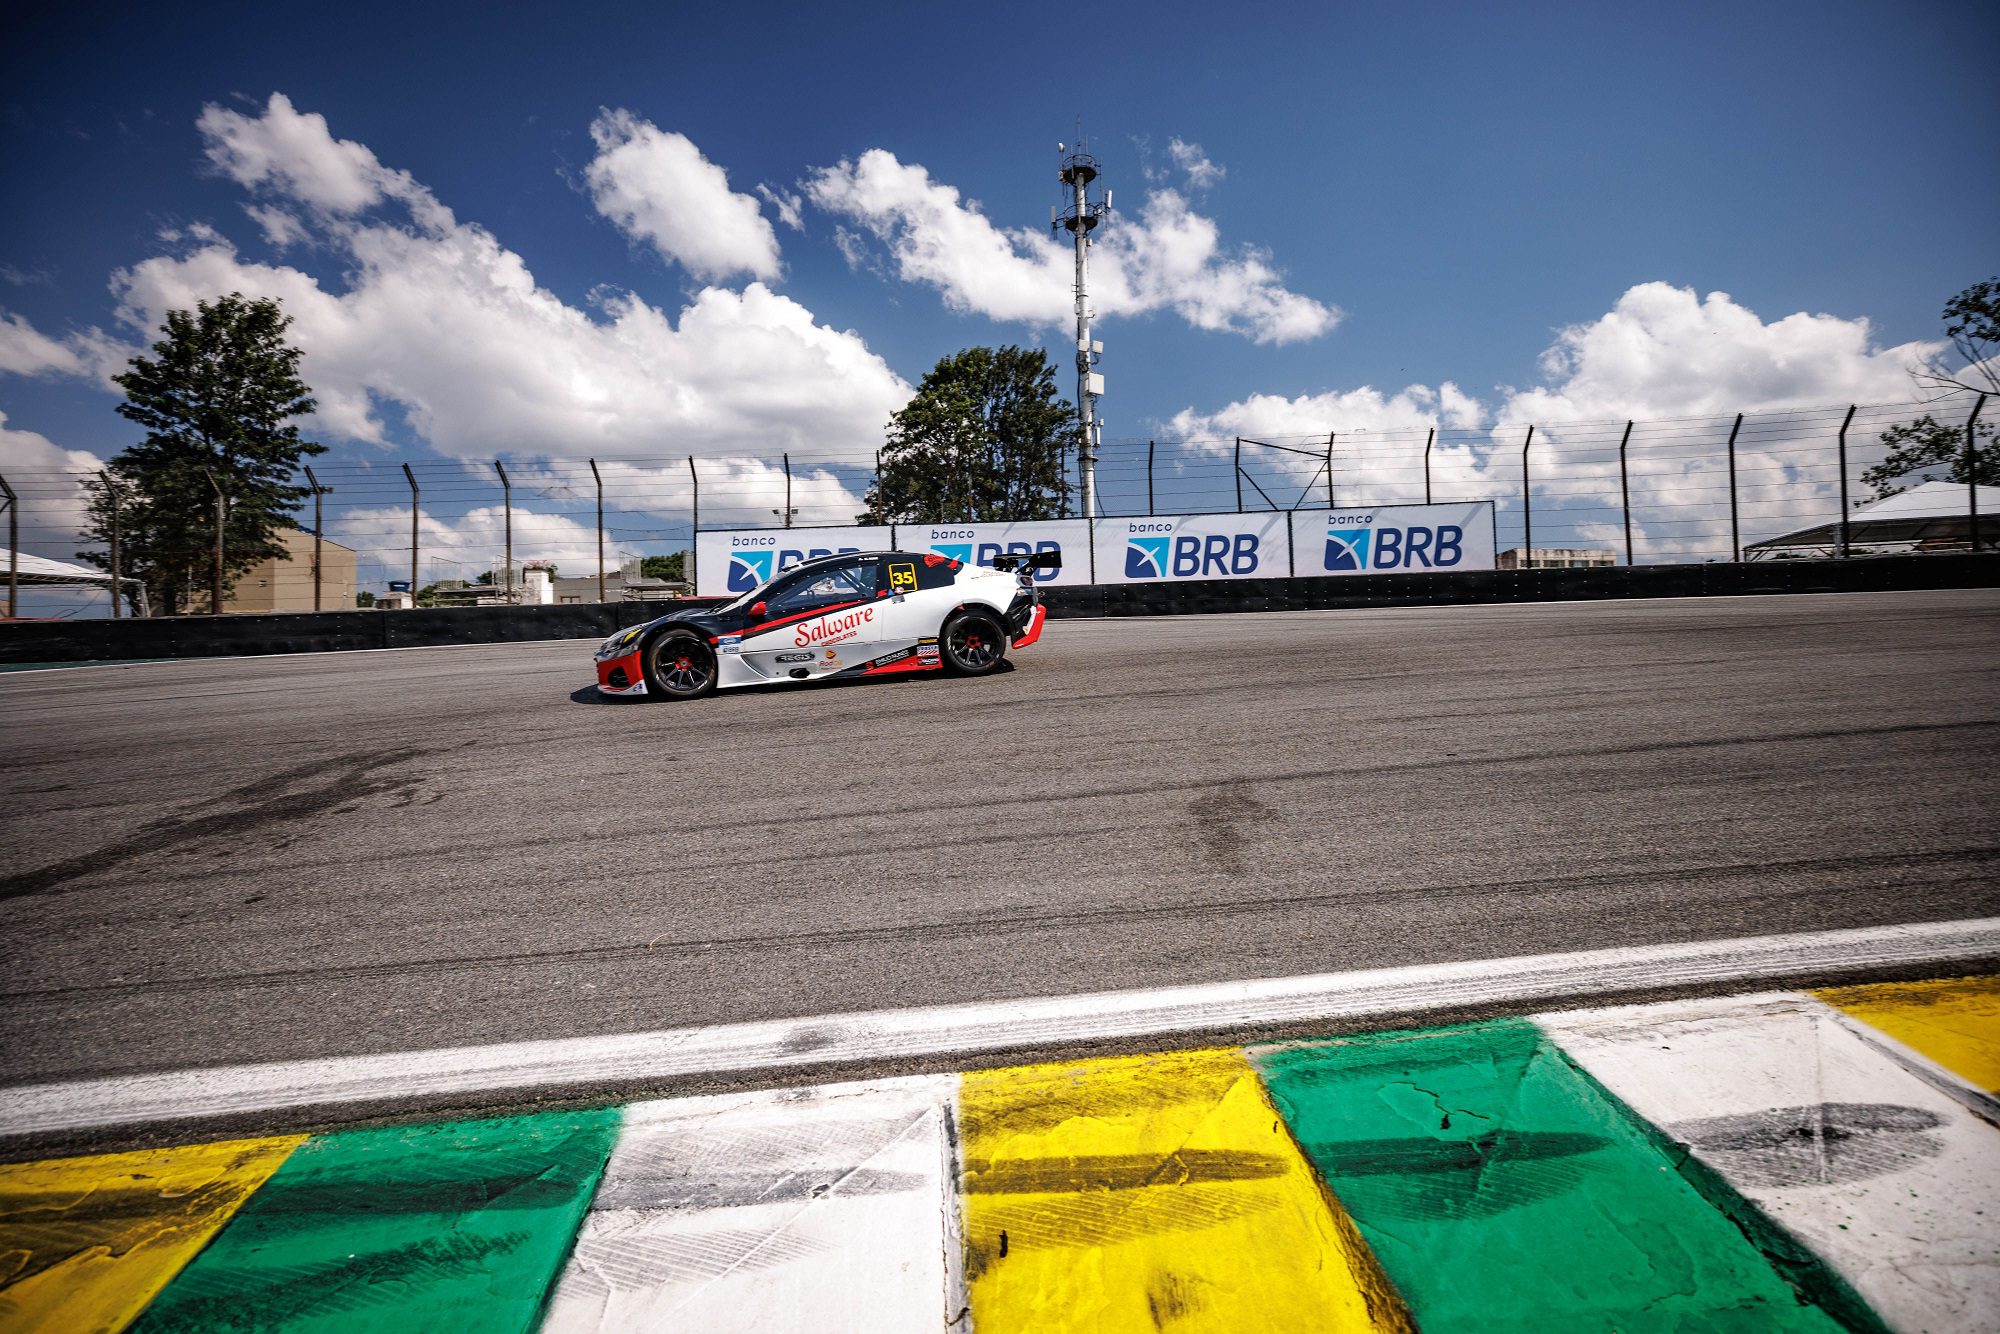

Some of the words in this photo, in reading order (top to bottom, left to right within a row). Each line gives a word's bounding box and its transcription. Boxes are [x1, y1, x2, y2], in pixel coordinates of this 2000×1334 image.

[1328, 514, 1373, 526] banco
[931, 528, 975, 540] banco
[1128, 522, 1173, 533] banco
[732, 536, 776, 547] banco
[1373, 525, 1464, 570] BRB
[1172, 533, 1259, 577] BRB
[892, 571, 914, 585] 35
[794, 607, 875, 648] Salware
